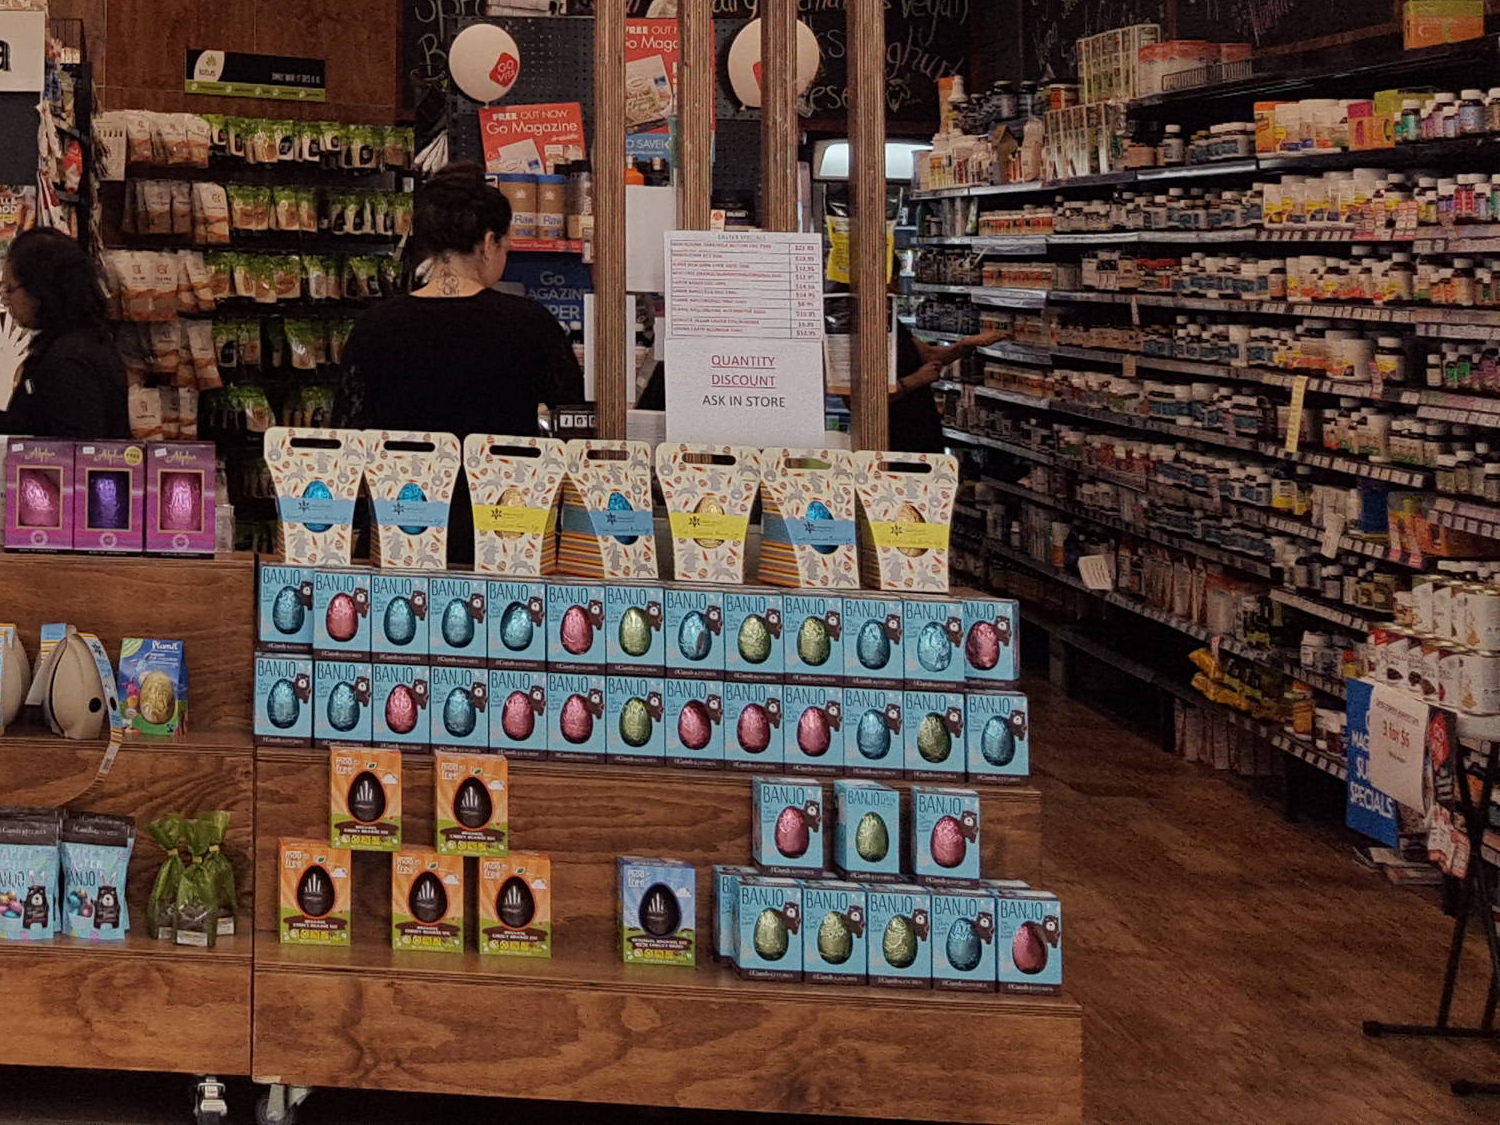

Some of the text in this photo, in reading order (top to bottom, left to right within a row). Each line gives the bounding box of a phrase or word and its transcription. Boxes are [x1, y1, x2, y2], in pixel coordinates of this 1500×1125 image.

[652, 26, 672, 35] OUT
[497, 59, 514, 72] GO
[492, 109, 568, 121] FREE OUT NOW
[486, 121, 578, 136] Go Magazine
[539, 271, 565, 286] Go
[711, 354, 776, 368] QUANTITY
[711, 374, 776, 387] DISCOUNT
[702, 395, 786, 408] ASK IN STORE
[262, 568, 301, 585] BANJO
[315, 574, 354, 592] BANJO
[373, 577, 411, 595] BANJO
[431, 579, 470, 596] BANJO
[489, 581, 528, 600] BANJO
[548, 585, 588, 603] BANJO
[606, 586, 646, 604] BANJO
[667, 592, 706, 610] BANJO
[726, 595, 765, 613] BANJO
[785, 597, 825, 615] BANJO
[845, 600, 885, 618] BANJO
[963, 601, 995, 619] ANJO
[906, 602, 947, 620] BANJO
[257, 659, 296, 677] BANJO
[317, 663, 356, 681] BANJO
[374, 665, 413, 683] BANJO
[432, 669, 472, 687] BANJO
[491, 670, 531, 689] BANJO
[549, 674, 589, 692] BANJO
[607, 678, 647, 696] BANJO
[667, 680, 707, 698] BANJO
[725, 683, 765, 702] BANJO
[785, 687, 825, 706] BANJO
[844, 688, 885, 707] BANJO
[905, 692, 947, 711] BANJO
[969, 693, 1010, 713] BANJO
[763, 785, 805, 804] BANJO
[847, 790, 880, 806] BANJO
[1350, 780, 1393, 819] SPECIALS
[919, 795, 961, 815] BANJO
[741, 888, 784, 907] BANJO
[806, 891, 848, 910] BANJO
[870, 895, 913, 914] BANJO
[935, 897, 977, 916] BANJO
[1000, 899, 1042, 919] BANJO
